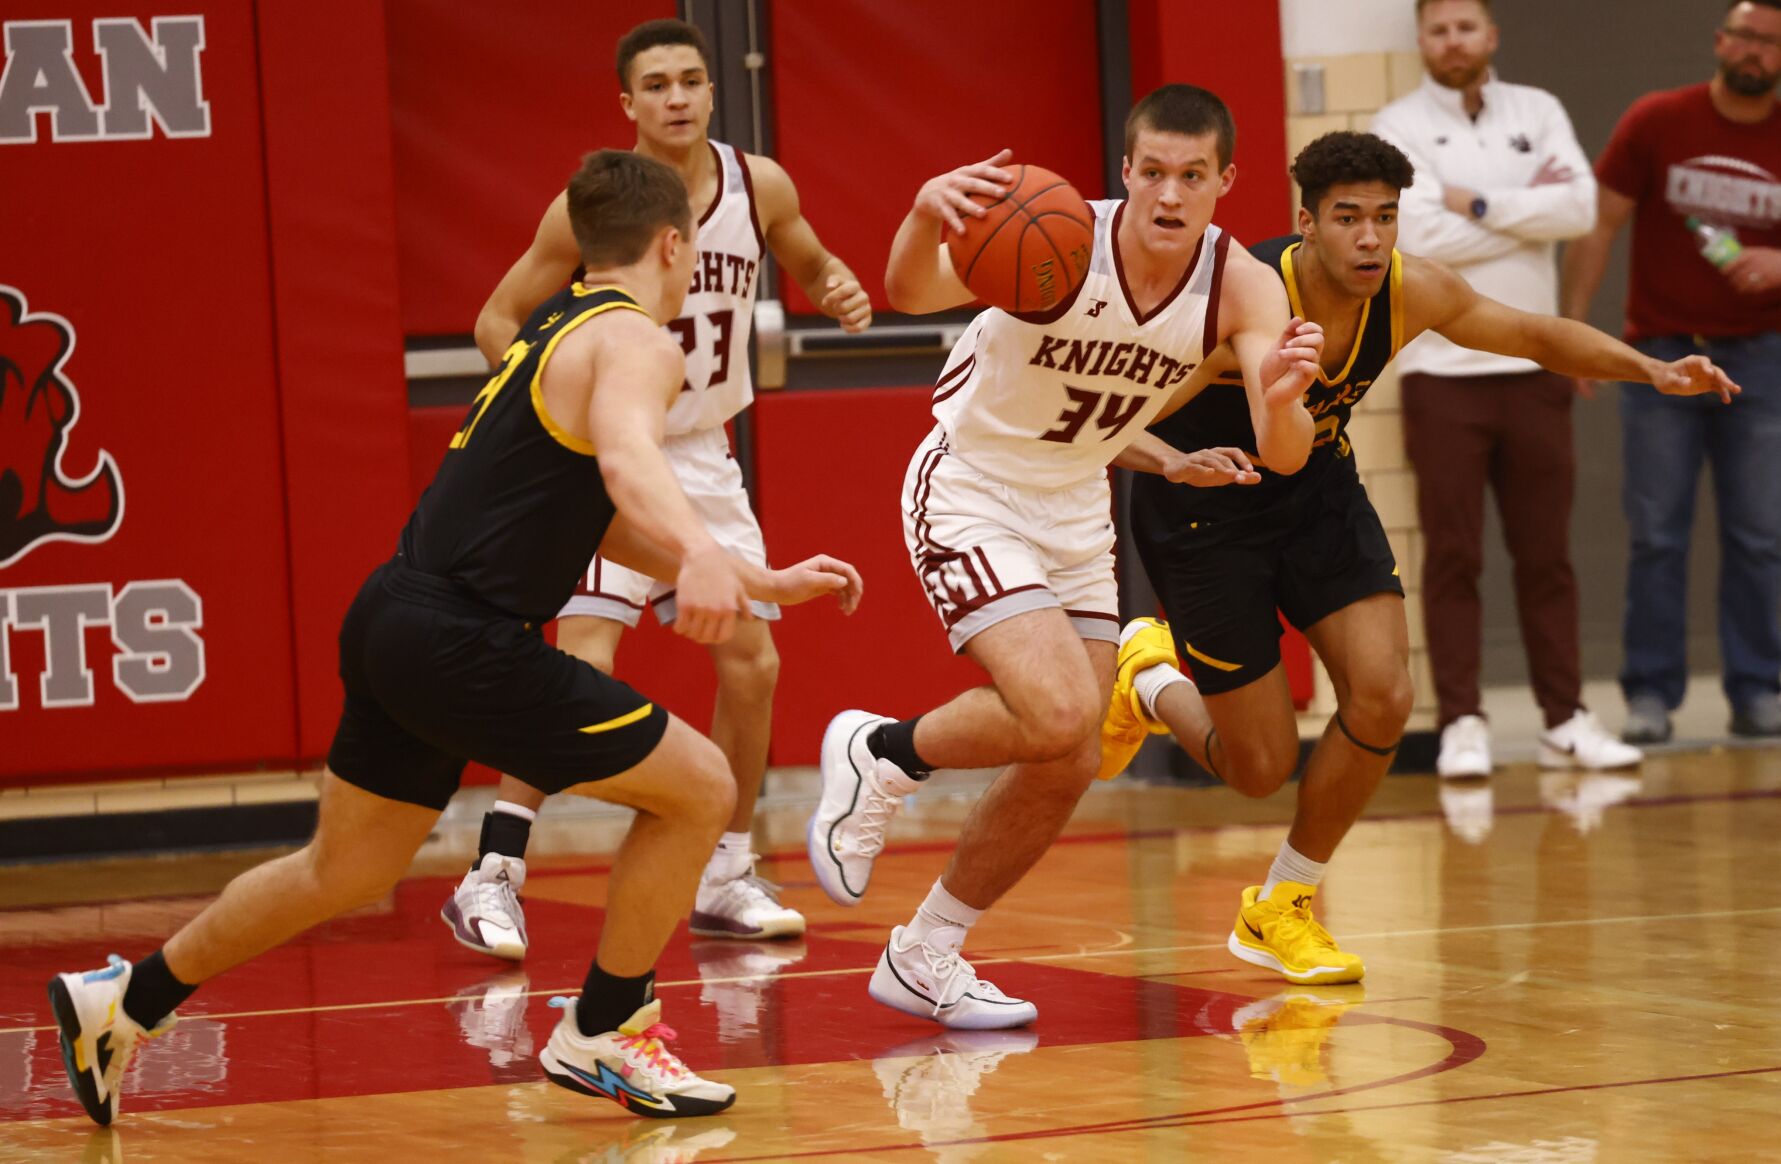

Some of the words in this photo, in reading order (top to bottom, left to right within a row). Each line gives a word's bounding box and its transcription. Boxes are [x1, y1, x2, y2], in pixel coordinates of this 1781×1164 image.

[1029, 334, 1197, 390] KNIGHTS
[1037, 383, 1151, 444] 34
[0, 578, 206, 711] TS
